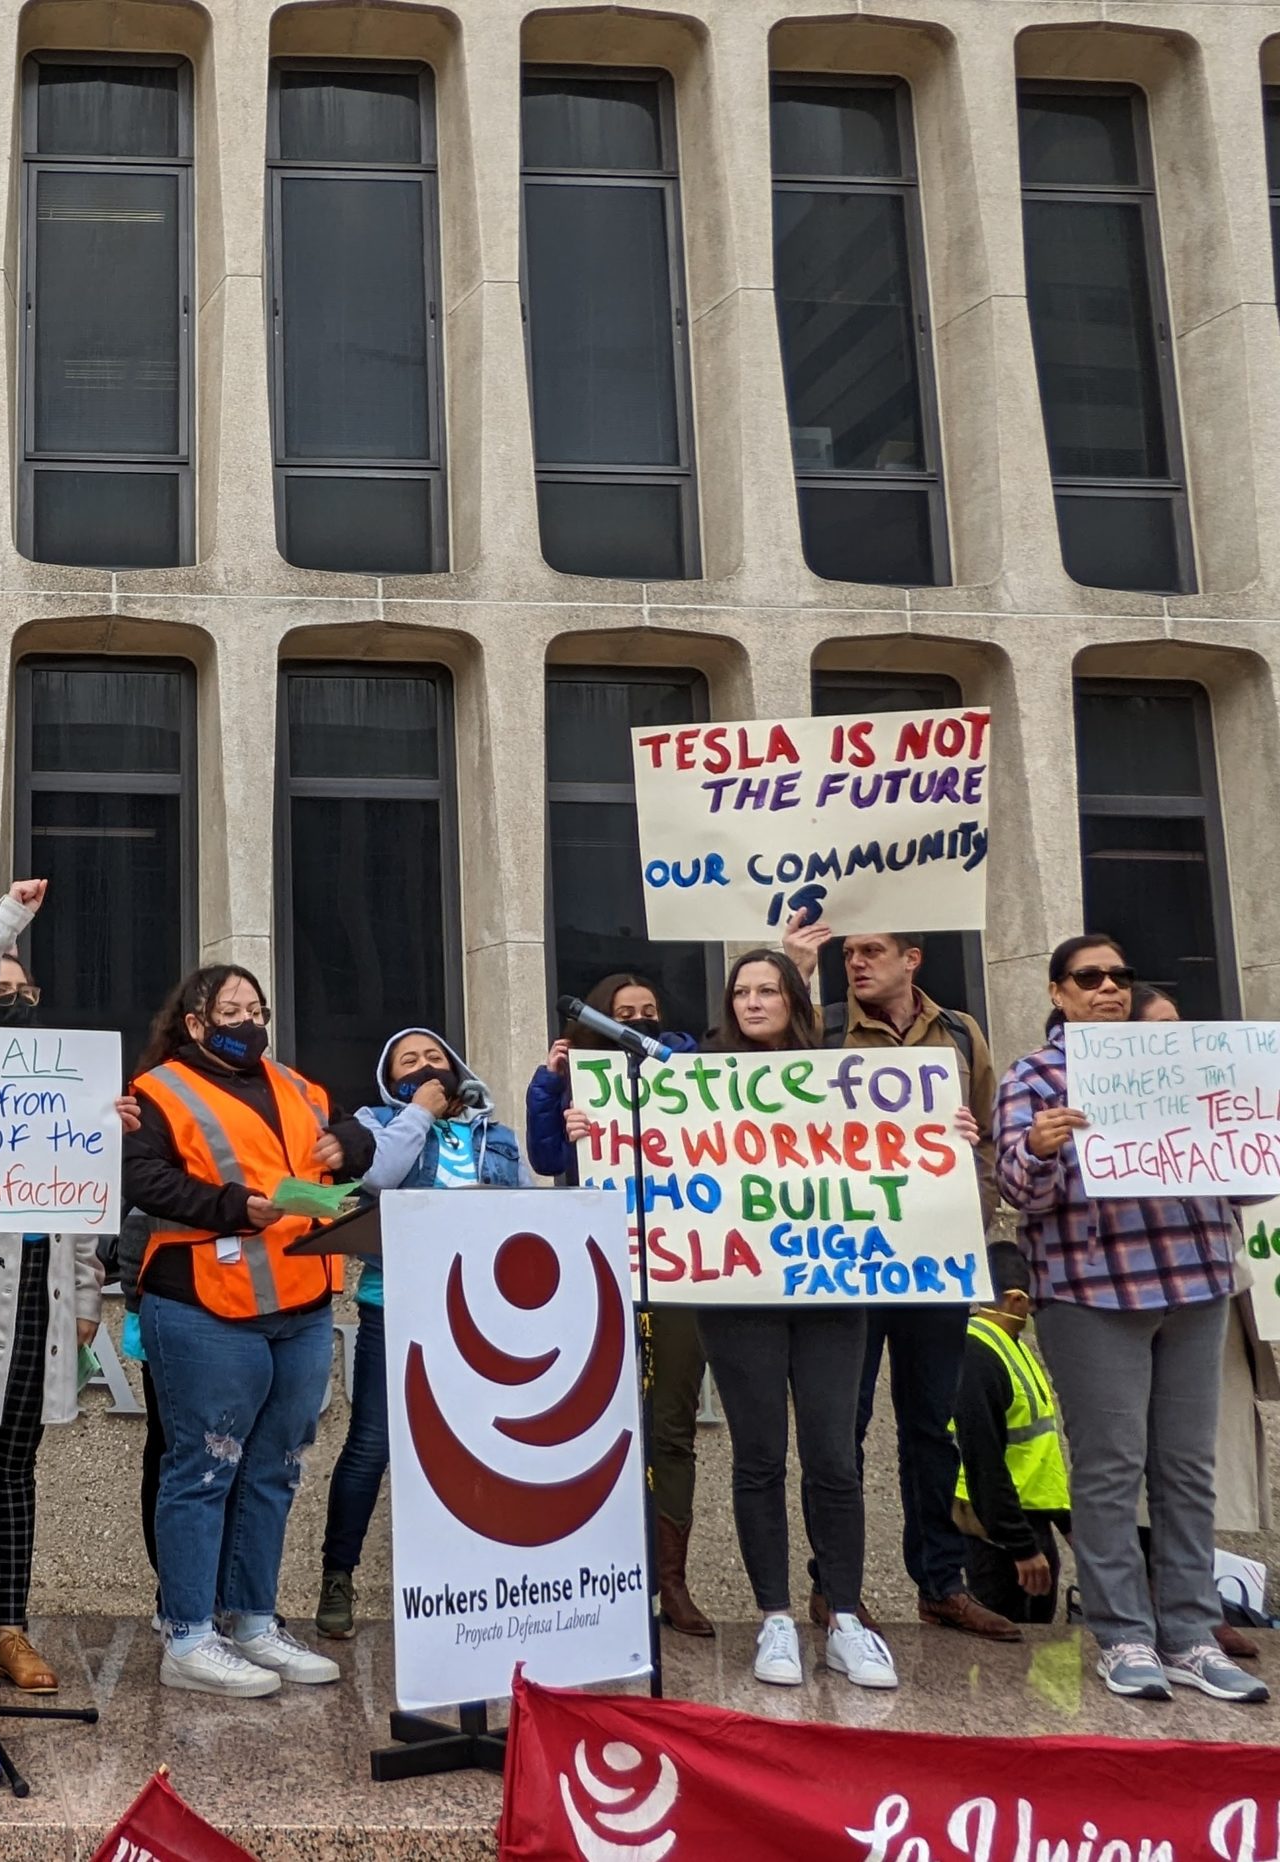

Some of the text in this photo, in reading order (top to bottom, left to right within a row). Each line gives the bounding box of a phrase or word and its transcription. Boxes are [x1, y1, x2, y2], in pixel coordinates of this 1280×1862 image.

[639, 711, 991, 774] TESLA IS NOT
[701, 764, 987, 814] THE FUTURE
[645, 820, 989, 888] OUR COMMUNITY
[767, 884, 828, 927] IS
[1, 1038, 81, 1077] ALL
[1070, 1025, 1280, 1060] JUSTICE FOR THE
[827, 1054, 949, 1113] for
[1075, 1063, 1237, 1097] WORKERS THAT
[1082, 1087, 1280, 1130] BUILT THE TESL
[46, 1119, 104, 1154] the
[587, 1119, 957, 1178] the WORKERS
[741, 1173, 909, 1222] BUILT
[770, 1222, 895, 1260] GIGA
[783, 1253, 977, 1297] FACTORY
[403, 1563, 642, 1619] Workers Defense Project
[455, 1605, 601, 1650] Proyecto Defensa Laboral
